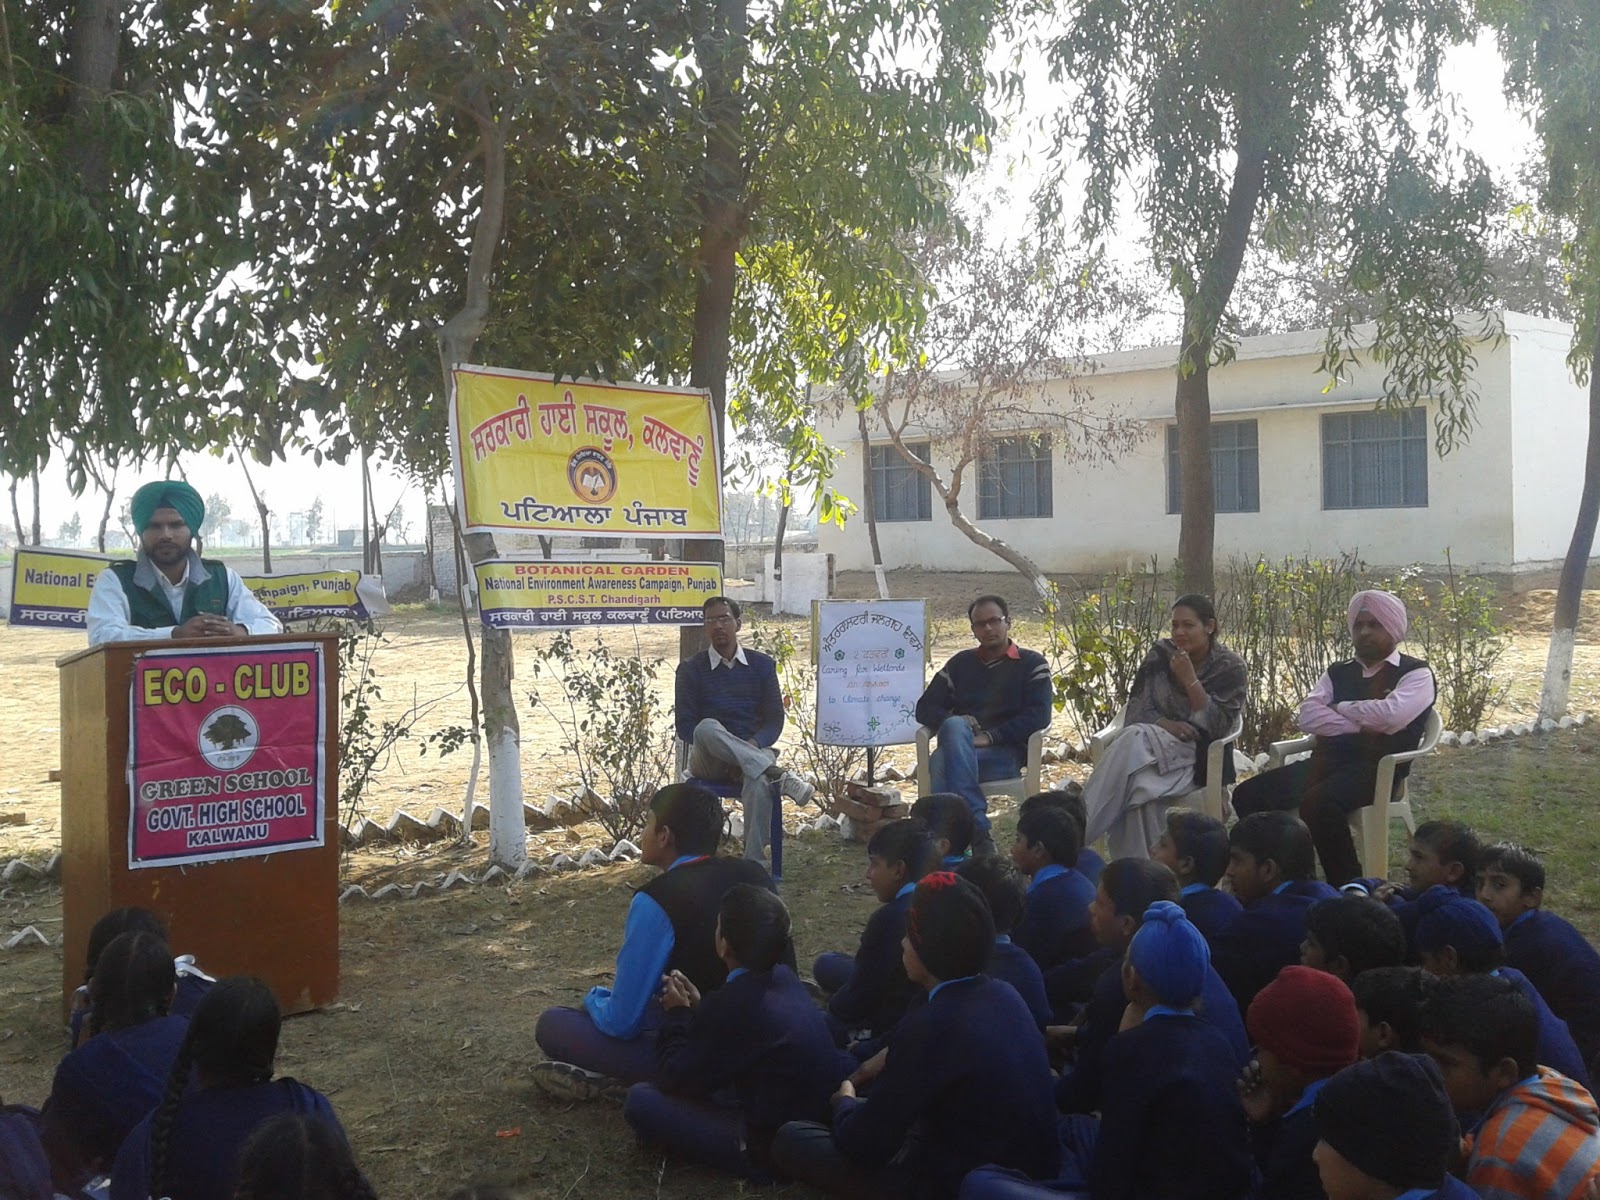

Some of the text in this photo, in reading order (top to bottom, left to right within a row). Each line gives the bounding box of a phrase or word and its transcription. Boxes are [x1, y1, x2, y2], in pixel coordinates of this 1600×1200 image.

[470, 393, 533, 462] ਸਰਕਾਰੀ
[538, 390, 577, 435] ਹਾਈ
[582, 404, 634, 452] ਸਕੂਲ,
[501, 496, 688, 527] ਪਟਿਆਲਾ ਪੰਜਾਬ
[24, 567, 82, 588] National
[514, 565, 690, 577] BOTANICAL GARDEN
[252, 577, 351, 598] ampaign, Punjab
[485, 576, 717, 593] National Environment Awareness Campaign, Punjab
[547, 594, 661, 606] P.S.C.S.T. Chandigarh
[489, 608, 535, 622] ਸਰਕਾਰੀ
[539, 608, 568, 621] ਹਾਈ
[571, 610, 603, 624] ਸਕੂਲ
[854, 651, 859, 659] 2
[143, 661, 311, 706] ECO - CLUB
[141, 768, 312, 801] GREEN SCHOOL
[147, 794, 306, 832] GOVT. HIGH SCHOOL
[187, 823, 269, 848] KALWANU
